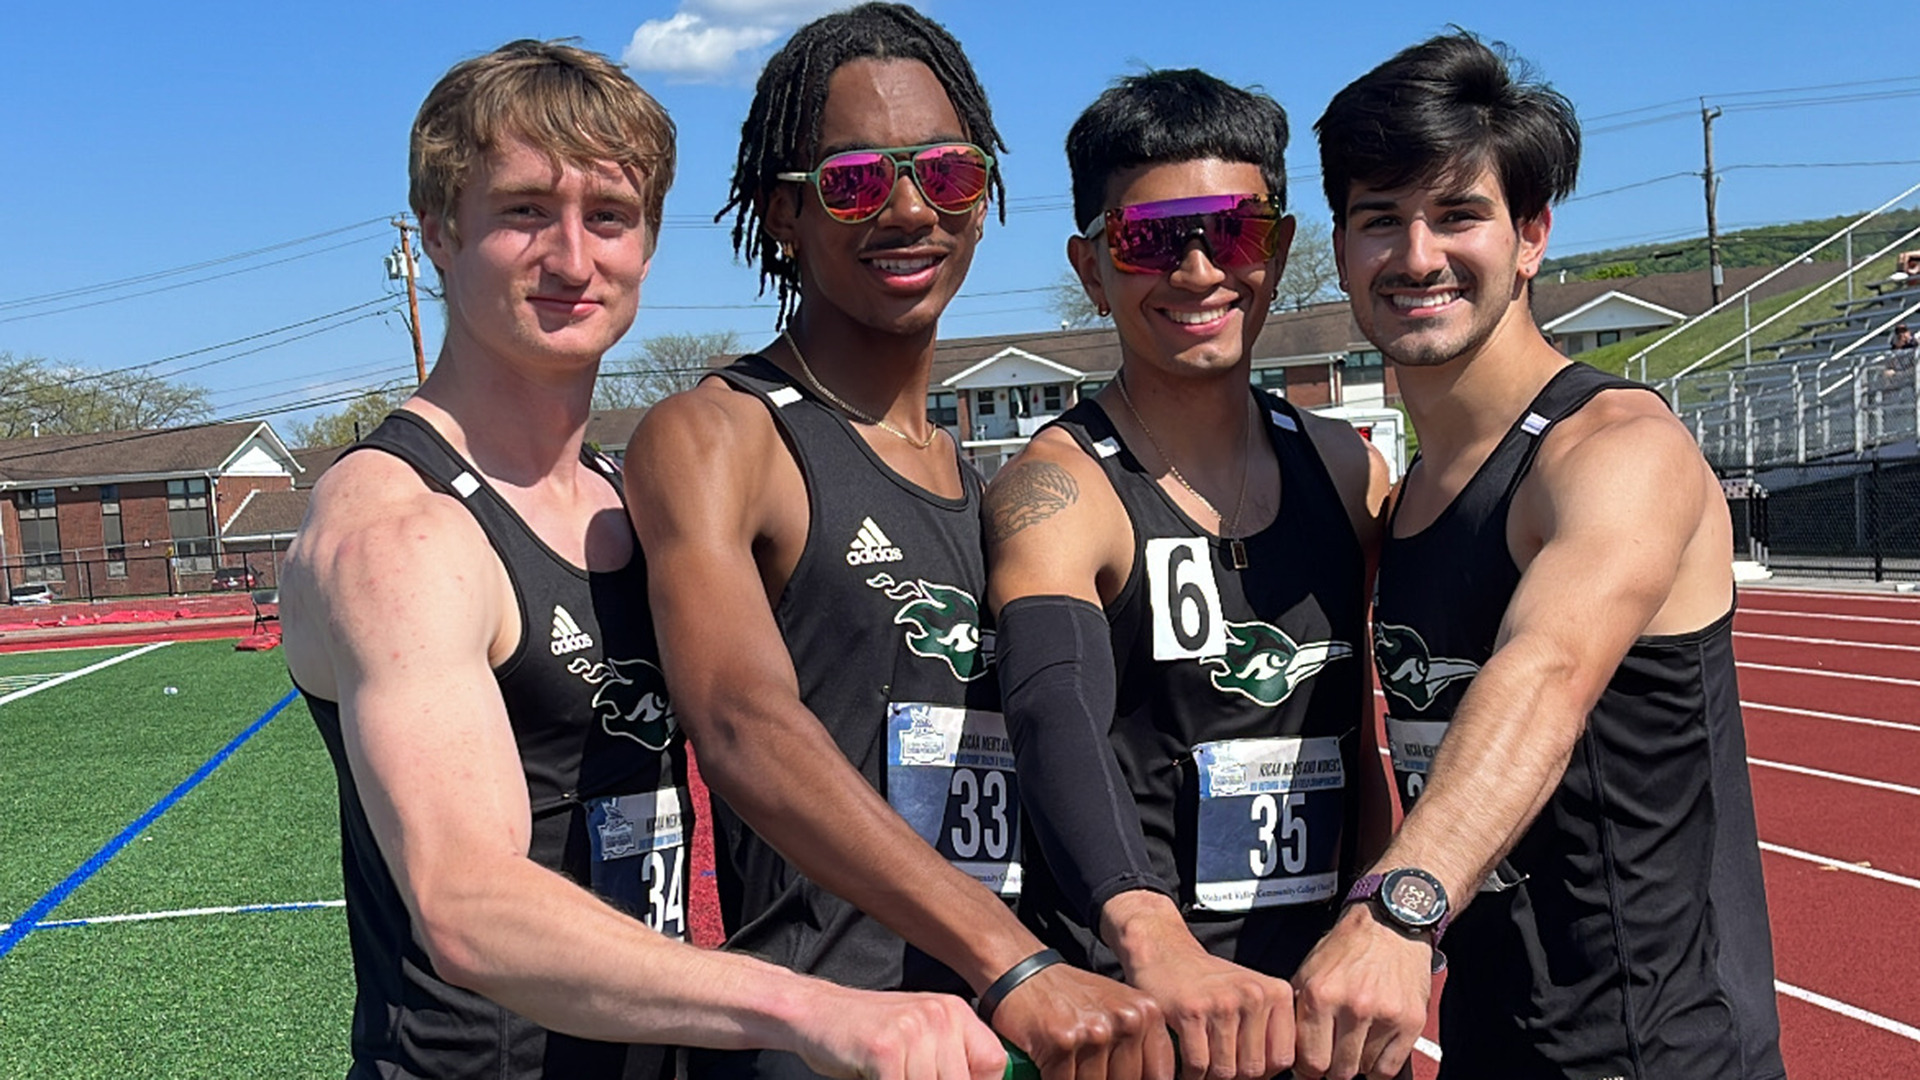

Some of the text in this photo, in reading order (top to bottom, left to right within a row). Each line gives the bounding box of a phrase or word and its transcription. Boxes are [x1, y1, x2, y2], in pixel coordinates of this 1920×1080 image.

[846, 546, 904, 566] adidas
[1168, 544, 1210, 652] 6
[550, 632, 593, 656] adidas
[951, 768, 1009, 859] 33
[1249, 792, 1307, 877] 35
[641, 846, 685, 934] 34
[1257, 886, 1296, 898] Community
